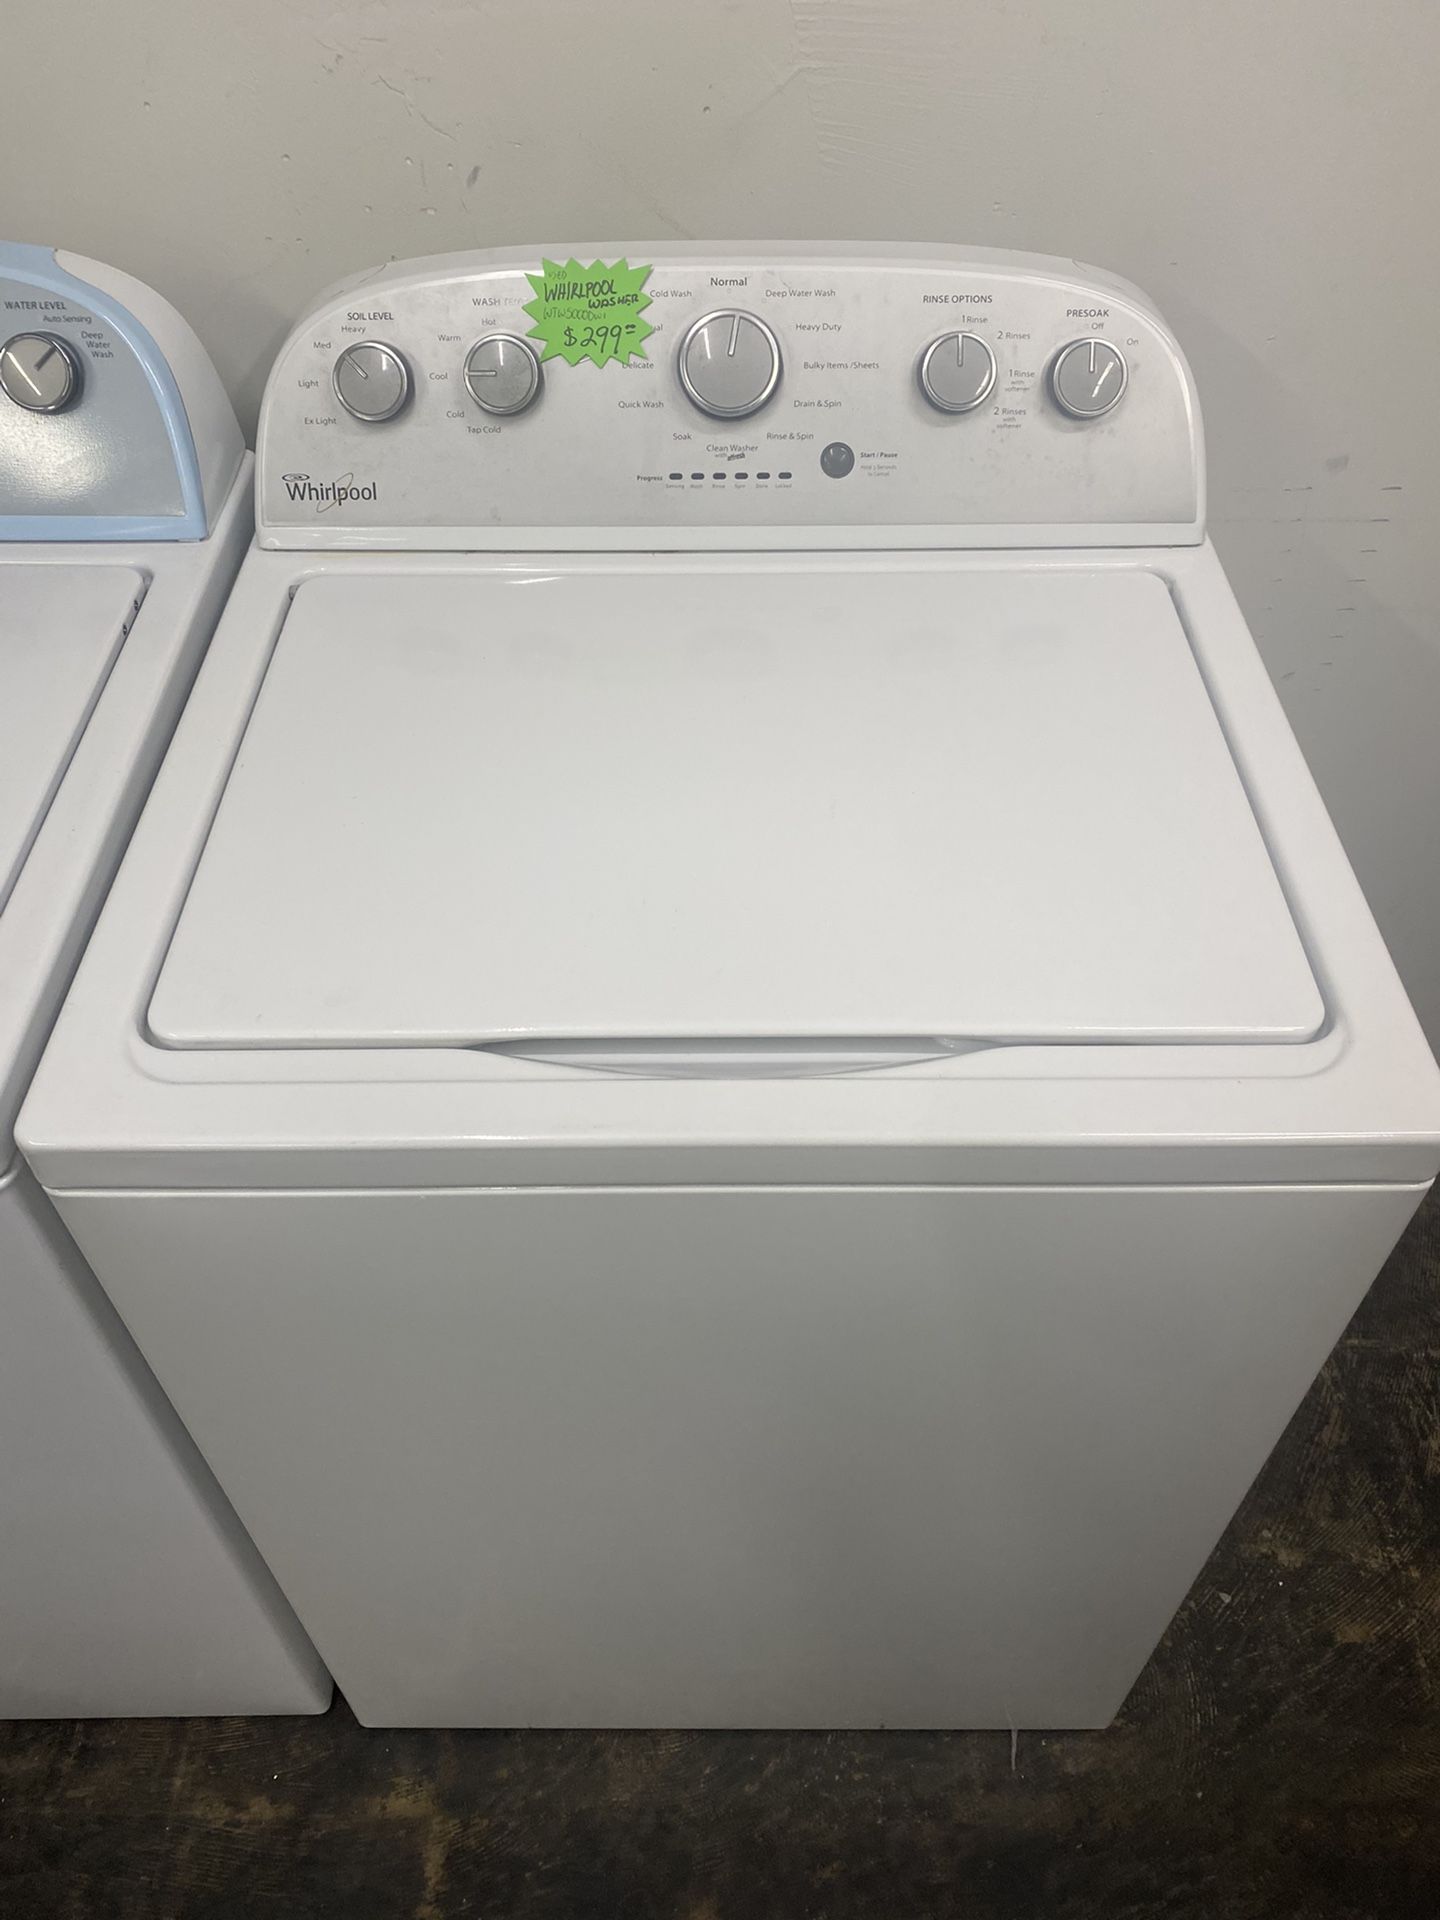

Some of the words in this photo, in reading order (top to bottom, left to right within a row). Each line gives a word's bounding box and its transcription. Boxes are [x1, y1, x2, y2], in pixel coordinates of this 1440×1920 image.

[710, 277, 748, 286] Normal
[544, 280, 617, 303] WHIRLPOOL
[649, 290, 669, 298] Cold
[670, 289, 692, 298] Wash
[765, 289, 787, 299] Deep
[789, 289, 813, 298] Water
[815, 289, 836, 298] Wash
[472, 298, 501, 306] WASH
[588, 294, 639, 309] WASHER
[923, 295, 950, 304] RINSE
[951, 295, 993, 304] OPTIONS
[4, 301, 38, 310] WATER
[38, 301, 67, 310] LEVEL
[347, 312, 367, 321] SOIL
[368, 312, 394, 321] LEVEL
[1066, 309, 1110, 318] PRESOAK
[43, 314, 61, 323] Auto
[62, 315, 92, 325] Sensing
[481, 318, 496, 326] Hot
[966, 316, 988, 324] Rinse
[341, 325, 366, 334] Heavy
[795, 322, 820, 332] Heavy
[821, 322, 841, 332] Duty
[1091, 322, 1105, 330] Off
[81, 331, 103, 340] Deep
[437, 334, 462, 342] Warm
[997, 331, 1003, 340] 2
[1005, 332, 1031, 340] Rinses
[86, 341, 111, 349] Water
[313, 341, 331, 349] Med
[1126, 337, 1139, 346] On
[91, 350, 114, 359] Wash
[803, 360, 825, 370] Bulky
[826, 361, 848, 369] Items
[429, 372, 448, 380] Cool
[1013, 370, 1035, 378] Rinse
[298, 379, 319, 389] Light
[618, 400, 643, 409] Quick
[643, 400, 664, 408] Wash
[793, 399, 816, 408] Drain
[817, 400, 823, 408] &
[823, 400, 842, 410] Spin
[446, 410, 465, 418] Cold
[993, 406, 1000, 416] 2
[1001, 407, 1026, 415] Rinses
[304, 417, 314, 425] Ex
[315, 416, 337, 426] Light
[467, 426, 481, 435] Tap
[482, 426, 501, 434] Cold
[672, 432, 692, 441] Soak
[766, 432, 787, 440] Rinse
[788, 432, 795, 440] &
[795, 432, 814, 442] Spin
[706, 444, 728, 452] Clean
[729, 444, 758, 452] Washer
[285, 482, 377, 506] Whirlpool
